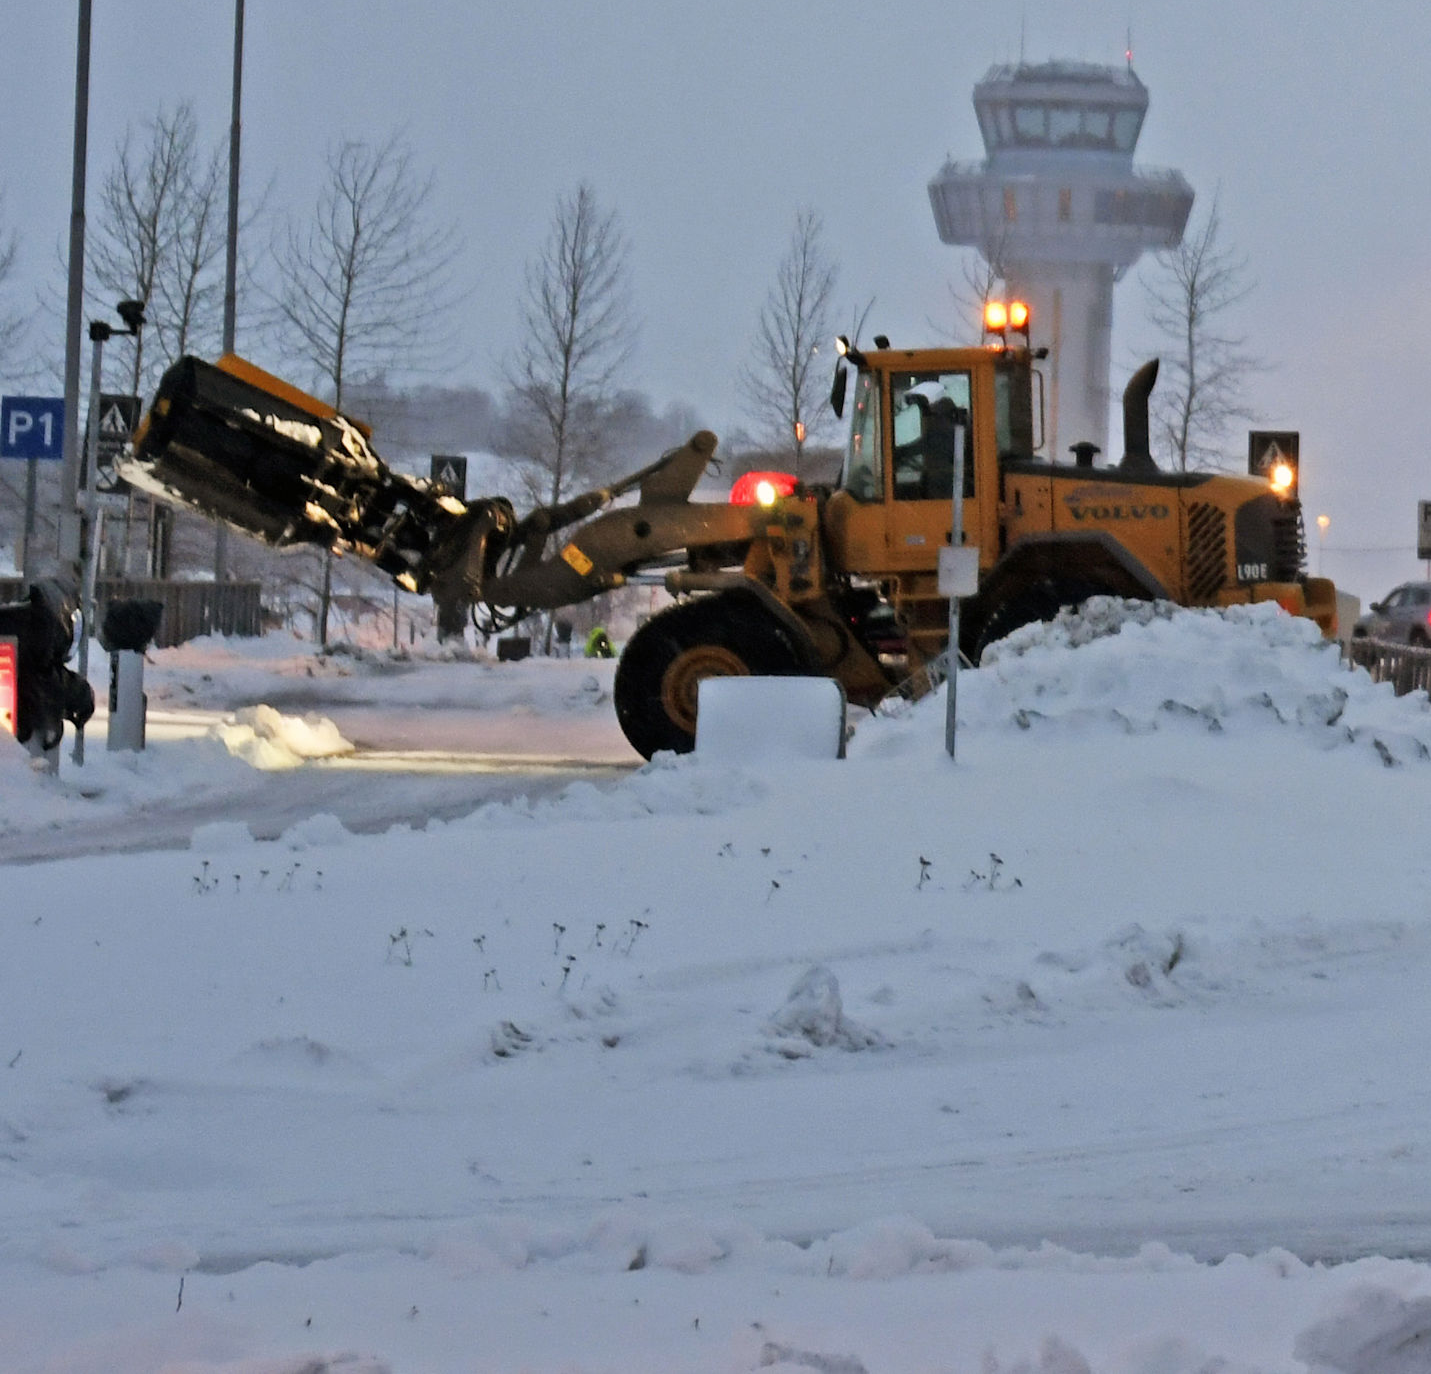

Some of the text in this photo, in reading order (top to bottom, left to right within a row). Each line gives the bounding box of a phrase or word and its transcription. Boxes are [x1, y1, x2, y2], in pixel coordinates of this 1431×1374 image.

[8, 409, 54, 447] P1
[1068, 504, 1170, 521] VOLVO
[1238, 564, 1268, 580] L90E
